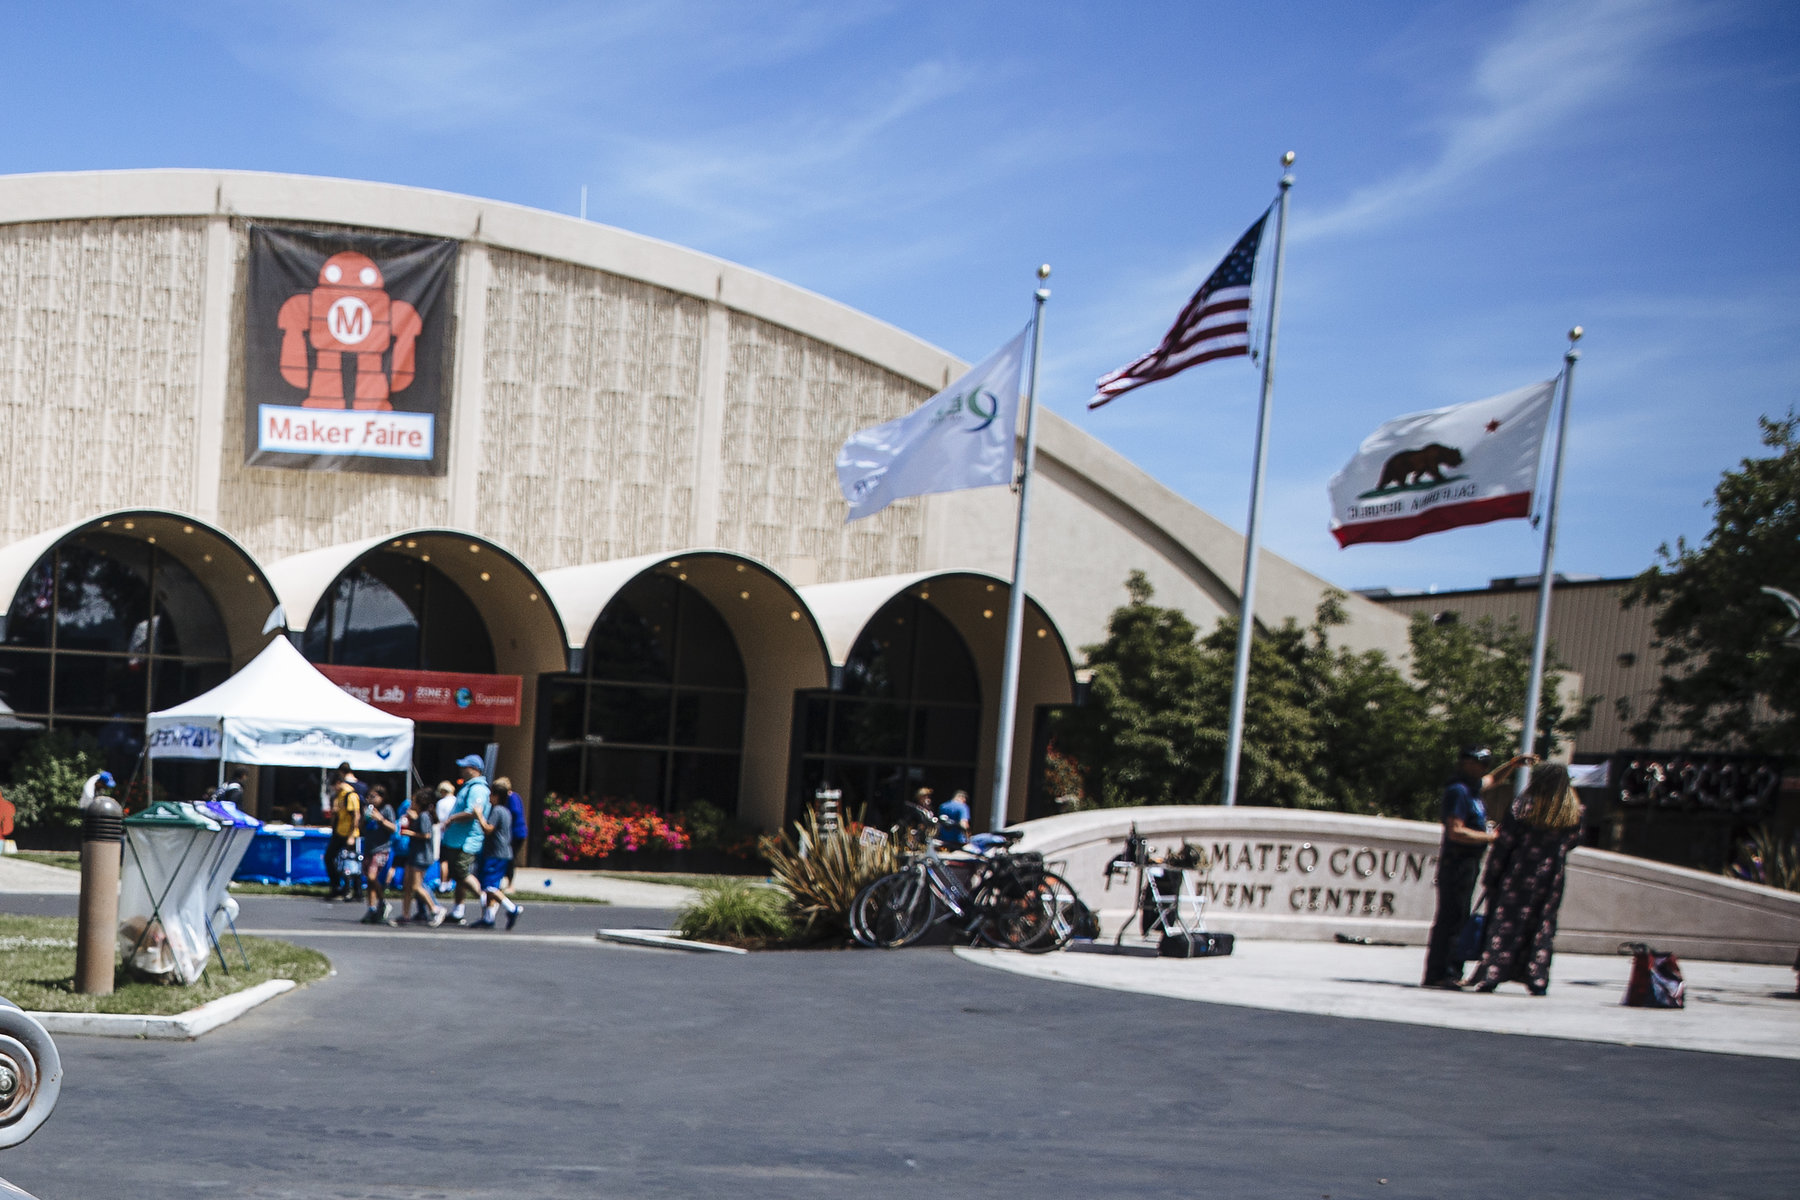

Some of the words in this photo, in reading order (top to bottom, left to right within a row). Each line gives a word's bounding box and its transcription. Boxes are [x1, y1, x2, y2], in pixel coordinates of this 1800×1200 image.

[336, 306, 364, 335] M
[269, 416, 354, 443] Maker
[362, 420, 424, 448] Faire
[372, 684, 405, 703] Lab
[1209, 843, 1319, 874] MATEO
[1329, 847, 1437, 883] COUN
[1195, 881, 1272, 907] EVENT
[1288, 886, 1395, 916] CENTER
